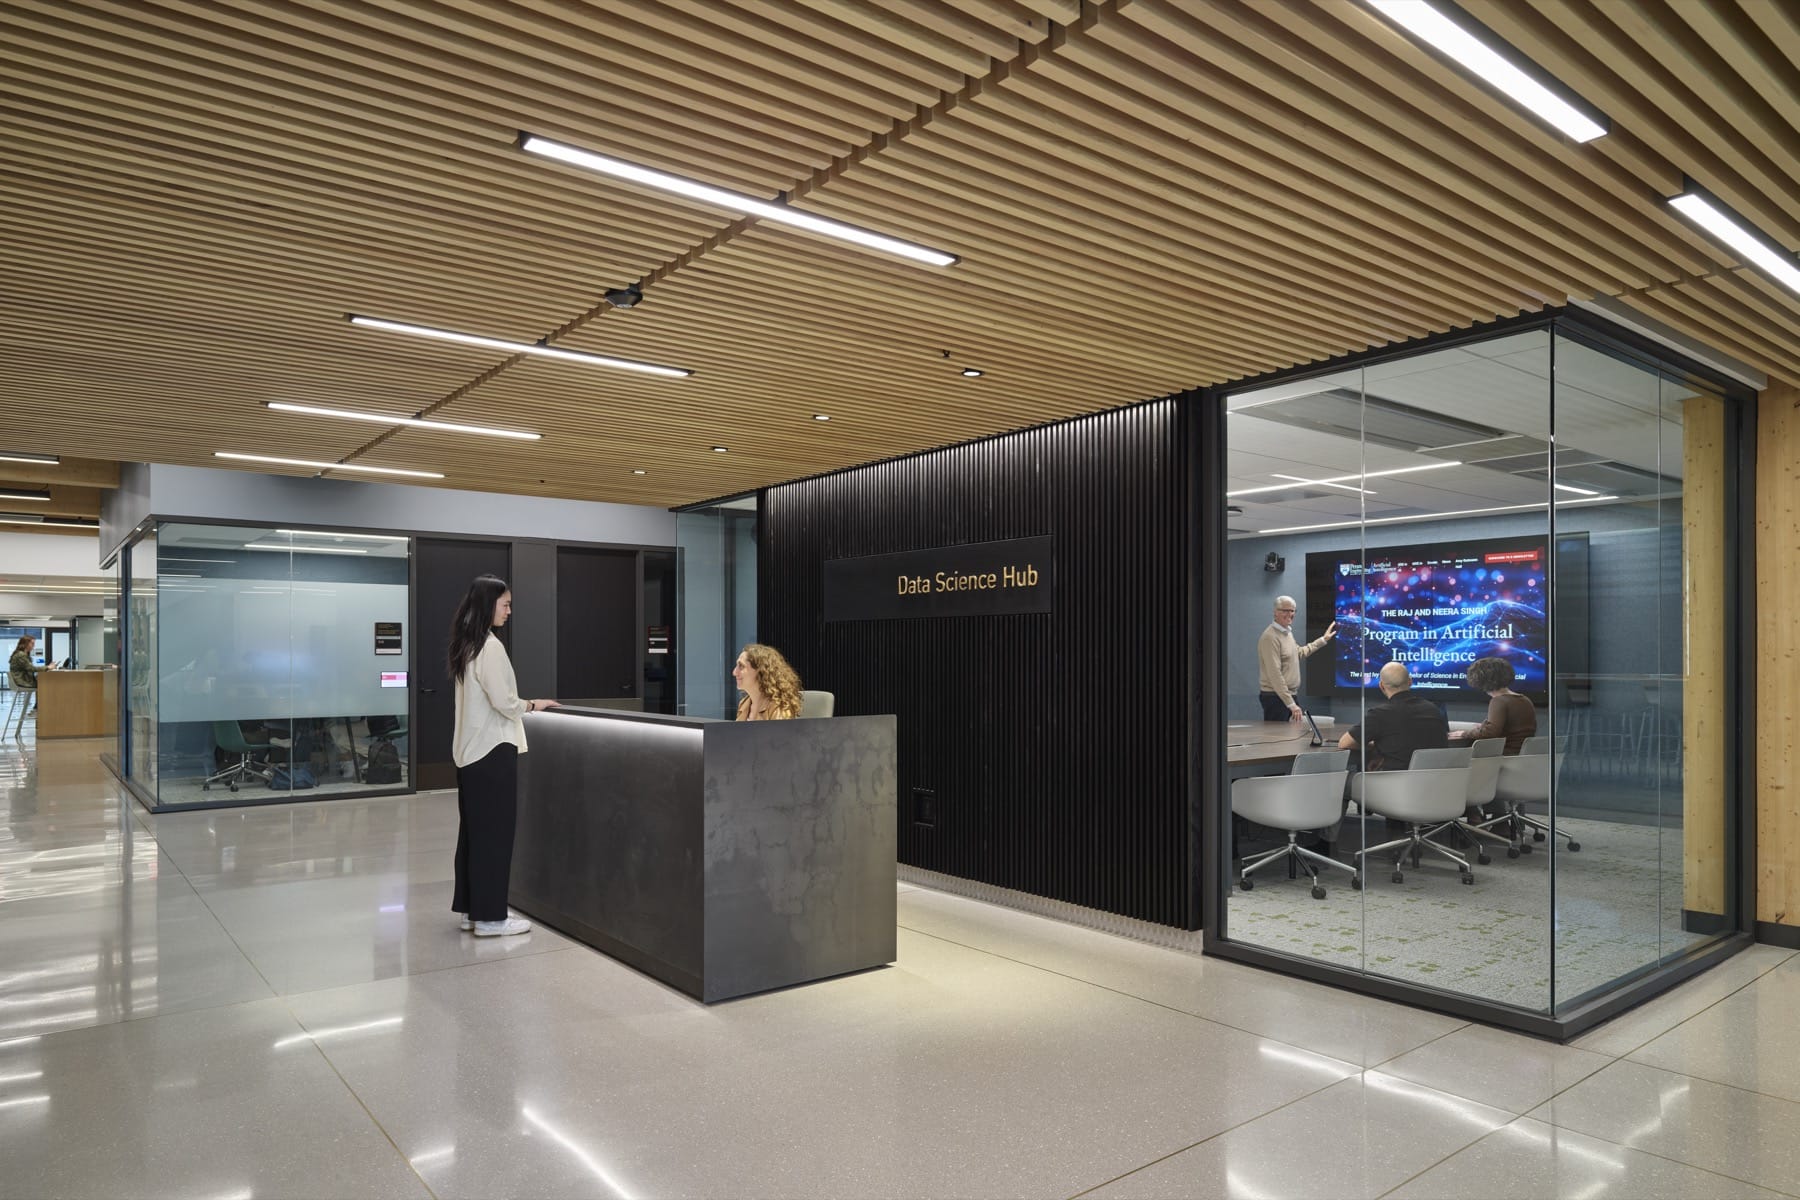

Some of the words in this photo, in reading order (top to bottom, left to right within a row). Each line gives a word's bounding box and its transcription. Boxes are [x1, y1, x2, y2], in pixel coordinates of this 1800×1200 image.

[898, 575, 931, 595] Data
[935, 570, 997, 593] Science
[1003, 564, 1038, 588] Hub
[1381, 609, 1396, 617] THE
[1397, 609, 1413, 617] RAJ
[1414, 608, 1431, 616] AND
[1432, 607, 1459, 616] NEERA
[1460, 607, 1487, 615] SINGH
[1363, 627, 1418, 645] Program
[1423, 626, 1437, 639] in
[1441, 623, 1513, 639] Artificial
[1391, 647, 1476, 667] Intelligence
